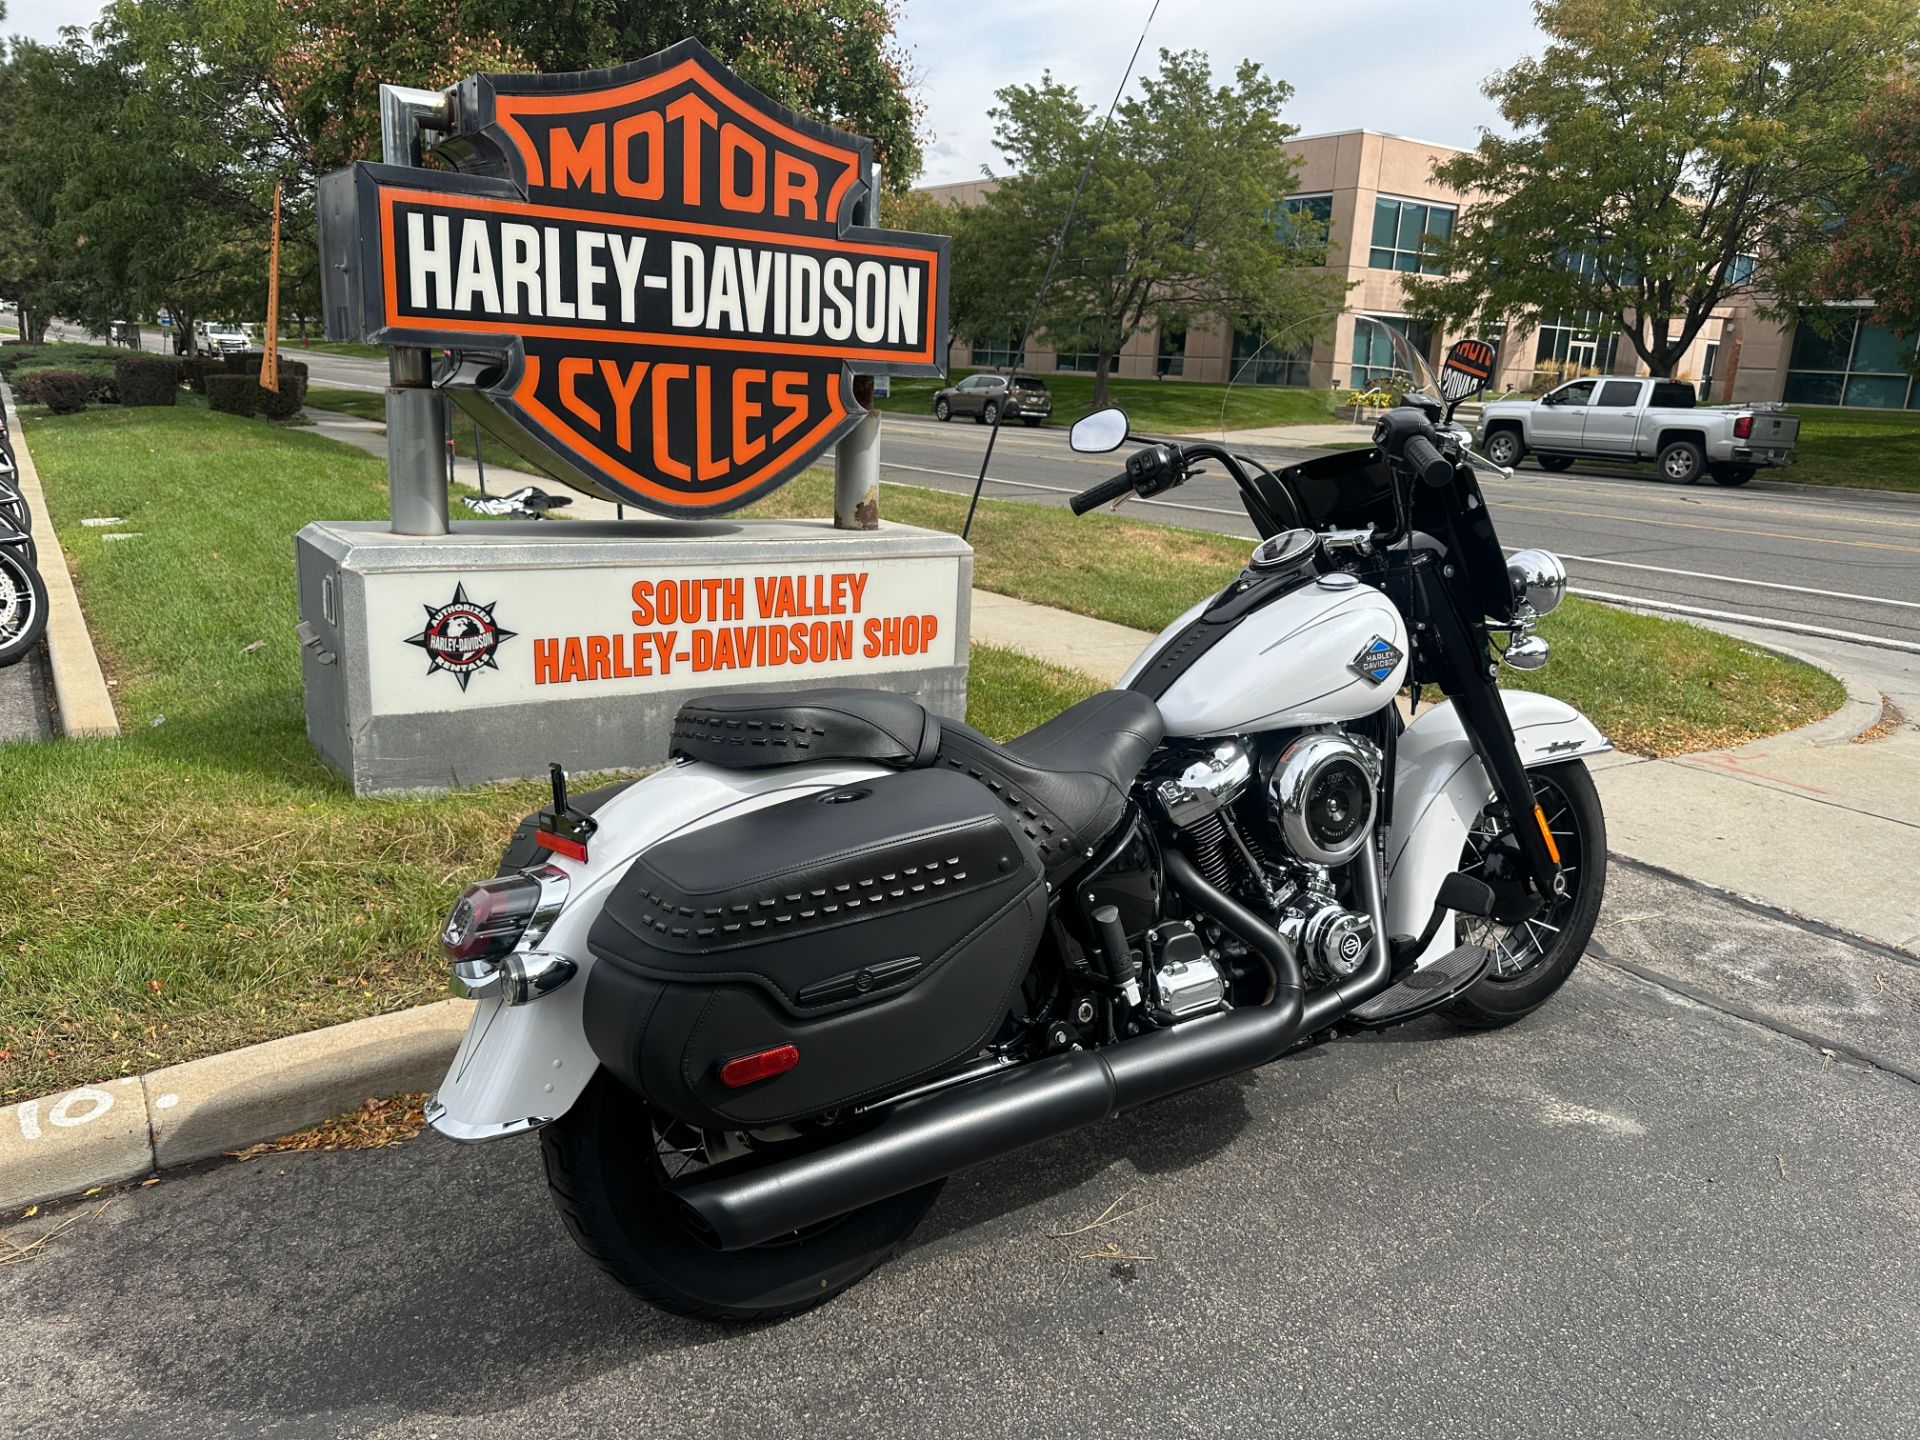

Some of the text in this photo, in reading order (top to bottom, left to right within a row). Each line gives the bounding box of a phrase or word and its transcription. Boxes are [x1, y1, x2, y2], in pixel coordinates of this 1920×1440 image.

[549, 92, 818, 221] MOTOR
[407, 212, 921, 346] HARLEY-DAVIDSON
[557, 356, 810, 482] CYCLES
[431, 603, 491, 627] AUTHORIZED
[631, 572, 869, 626] SOUTH VALLEY
[430, 631, 493, 652] HARLEY-DAVIDSON
[533, 615, 938, 685] HARLEY-DAVIDSON SHOP
[1366, 651, 1393, 662] HARLEY
[434, 653, 490, 672] RENTALS
[1363, 658, 1398, 671] DAVIDSON
